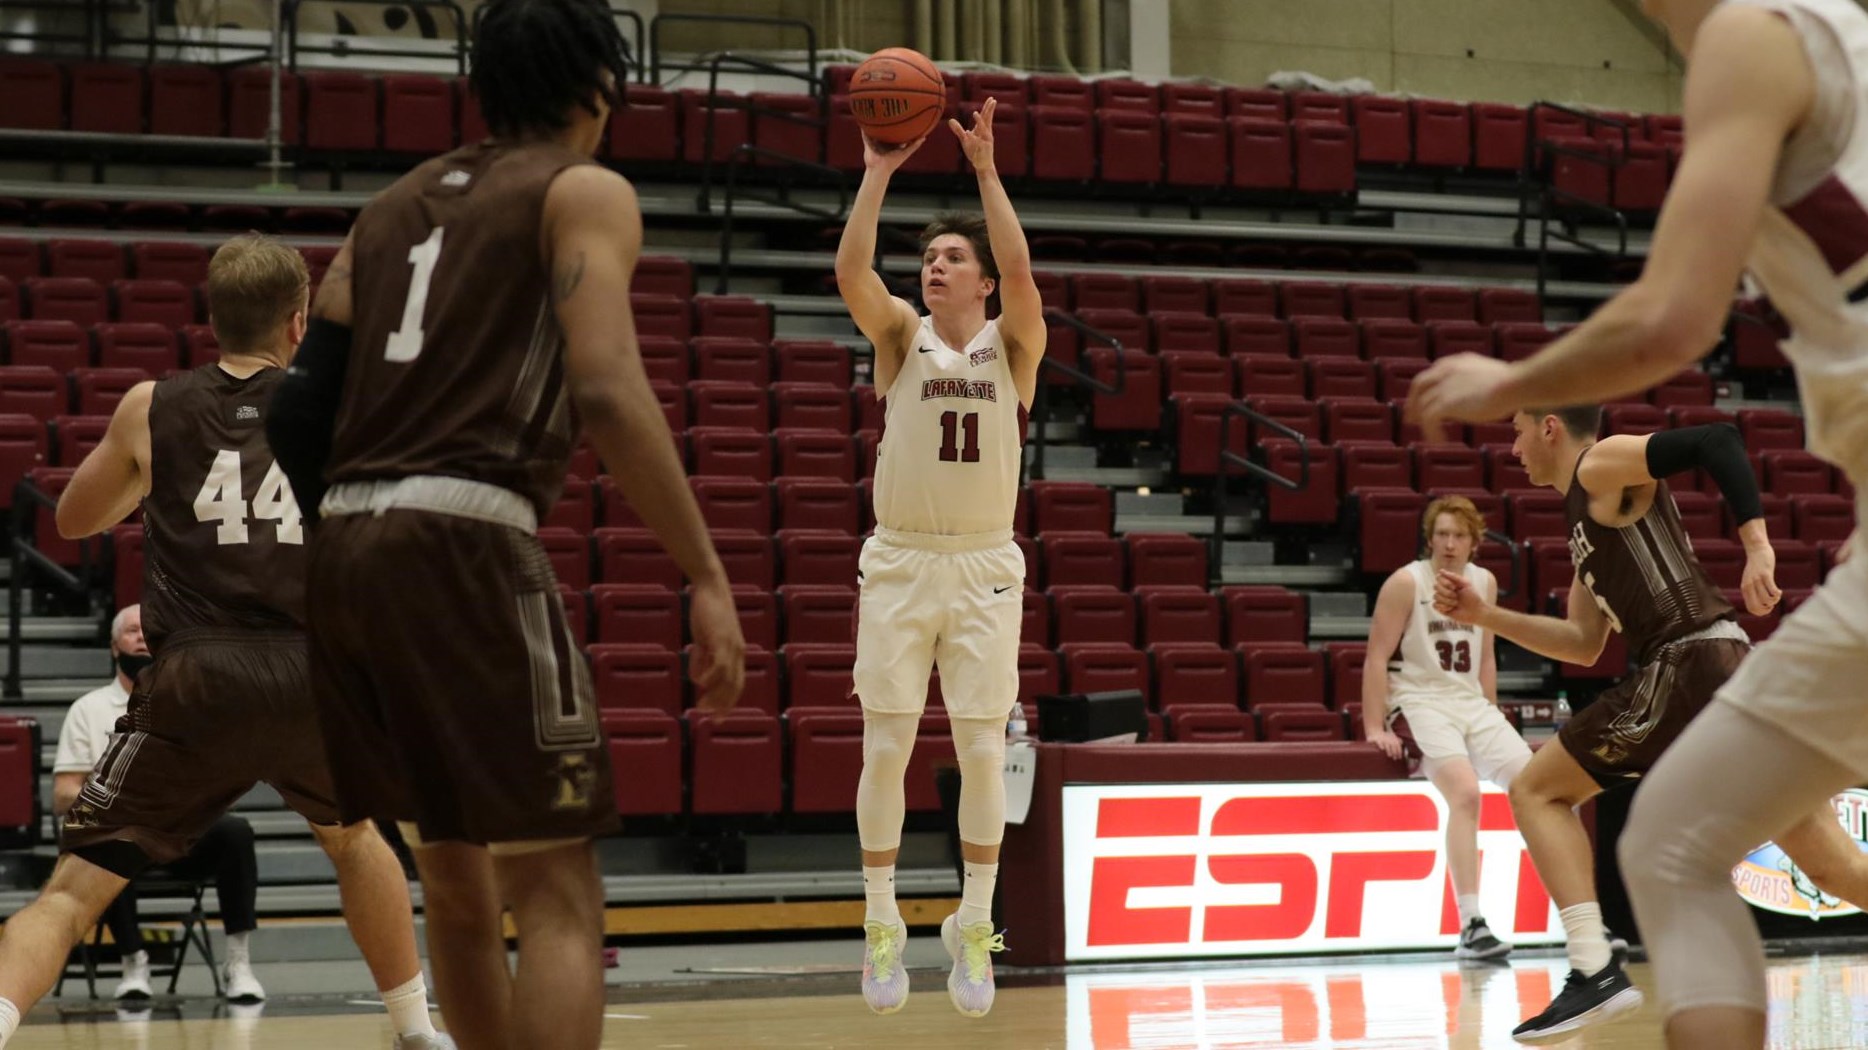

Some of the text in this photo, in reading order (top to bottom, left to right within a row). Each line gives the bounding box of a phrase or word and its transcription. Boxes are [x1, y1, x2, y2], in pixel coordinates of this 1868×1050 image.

[384, 226, 444, 362] 1
[921, 378, 997, 402] LAFAYETTE
[939, 410, 980, 462] 11
[193, 449, 304, 545] 44
[1435, 640, 1471, 673] 33
[1733, 865, 1790, 904] SPORTS
